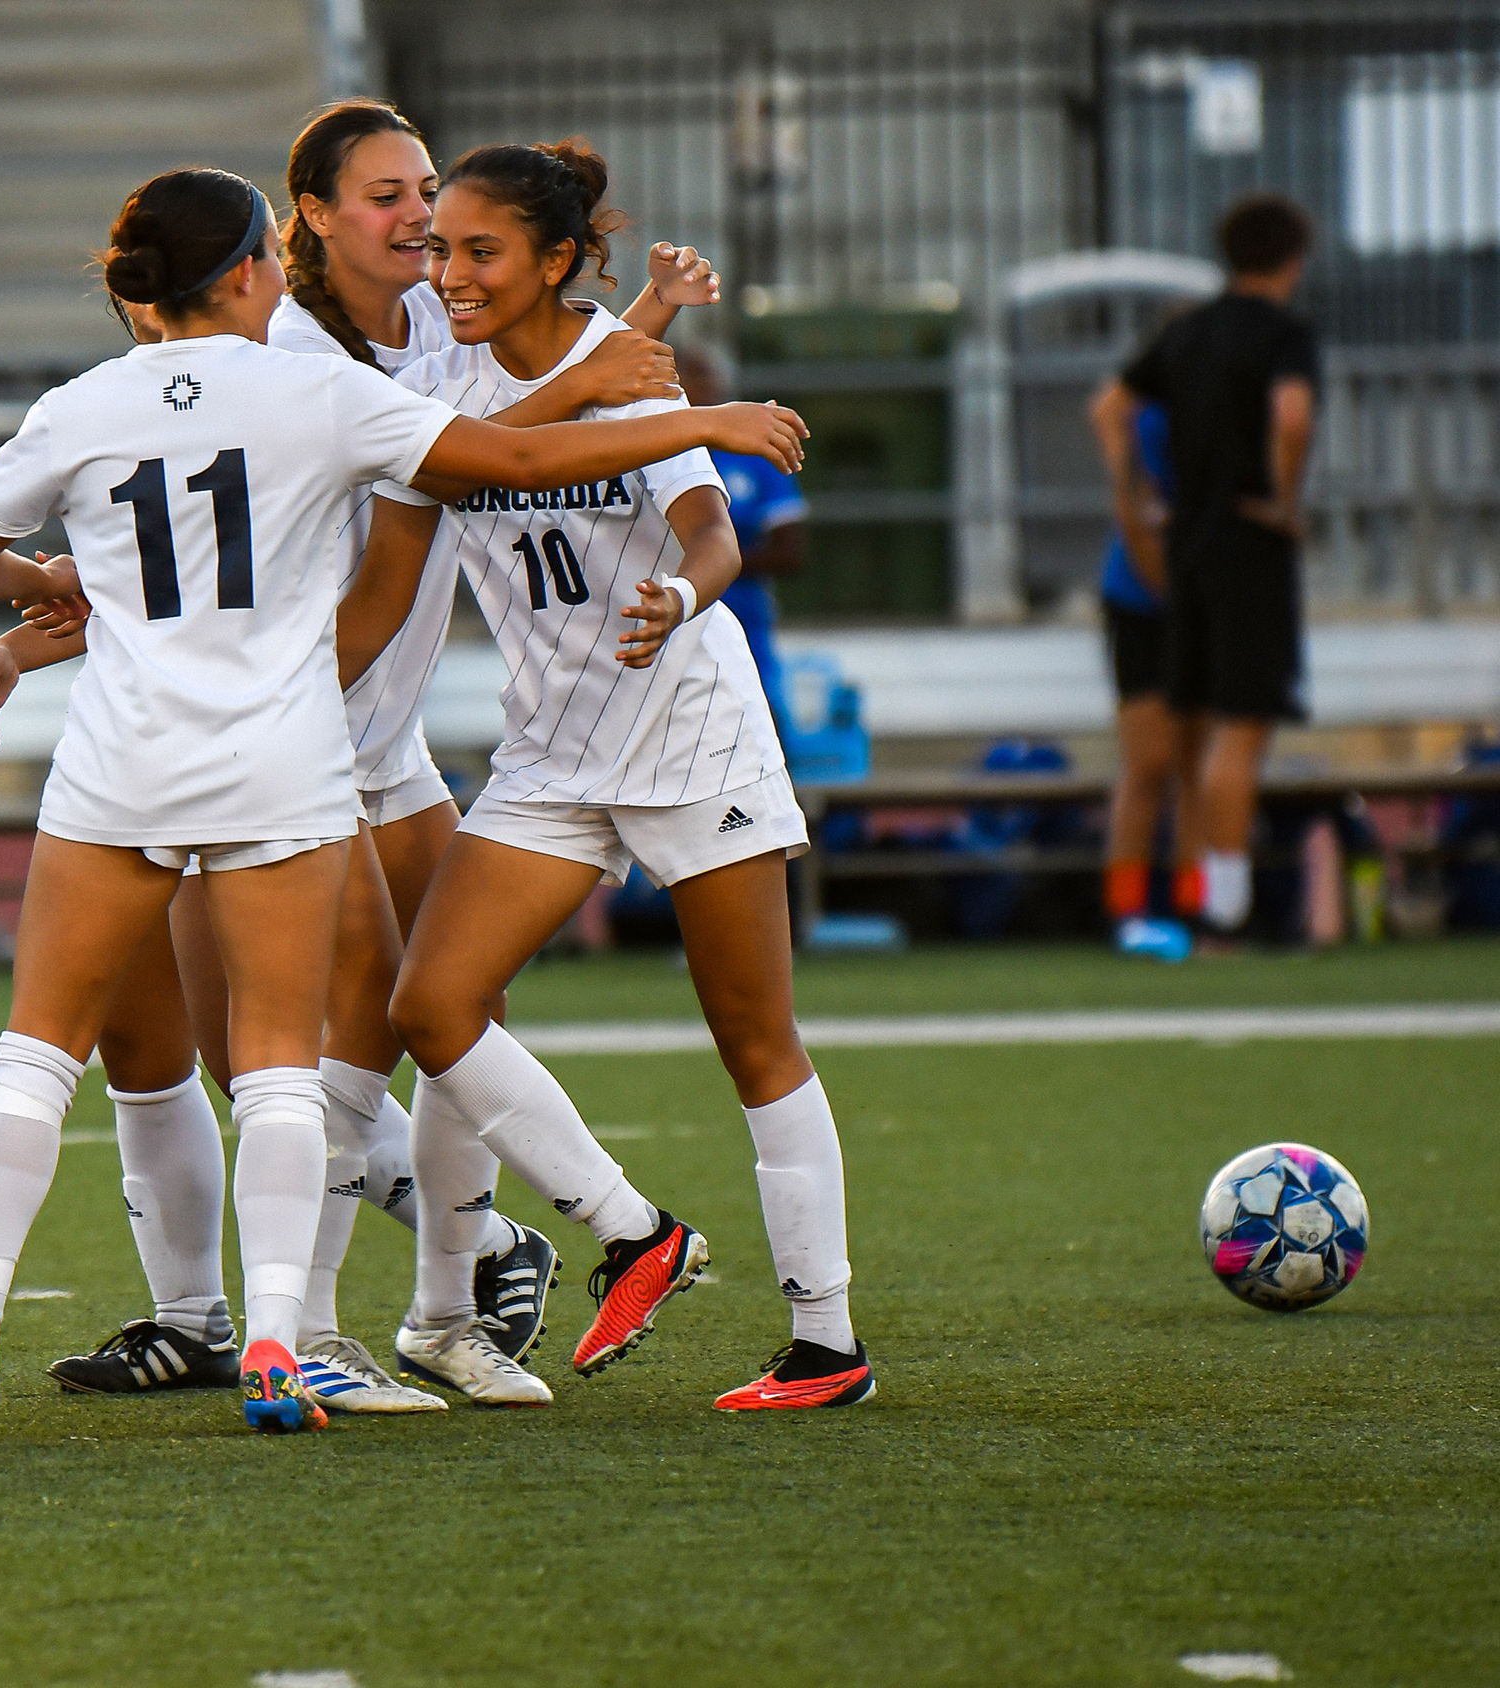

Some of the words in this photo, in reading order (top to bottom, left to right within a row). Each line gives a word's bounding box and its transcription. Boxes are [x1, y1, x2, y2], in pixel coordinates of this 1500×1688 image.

[109, 448, 255, 621] 11
[512, 528, 591, 611] 10
[718, 817, 754, 833] adidas
